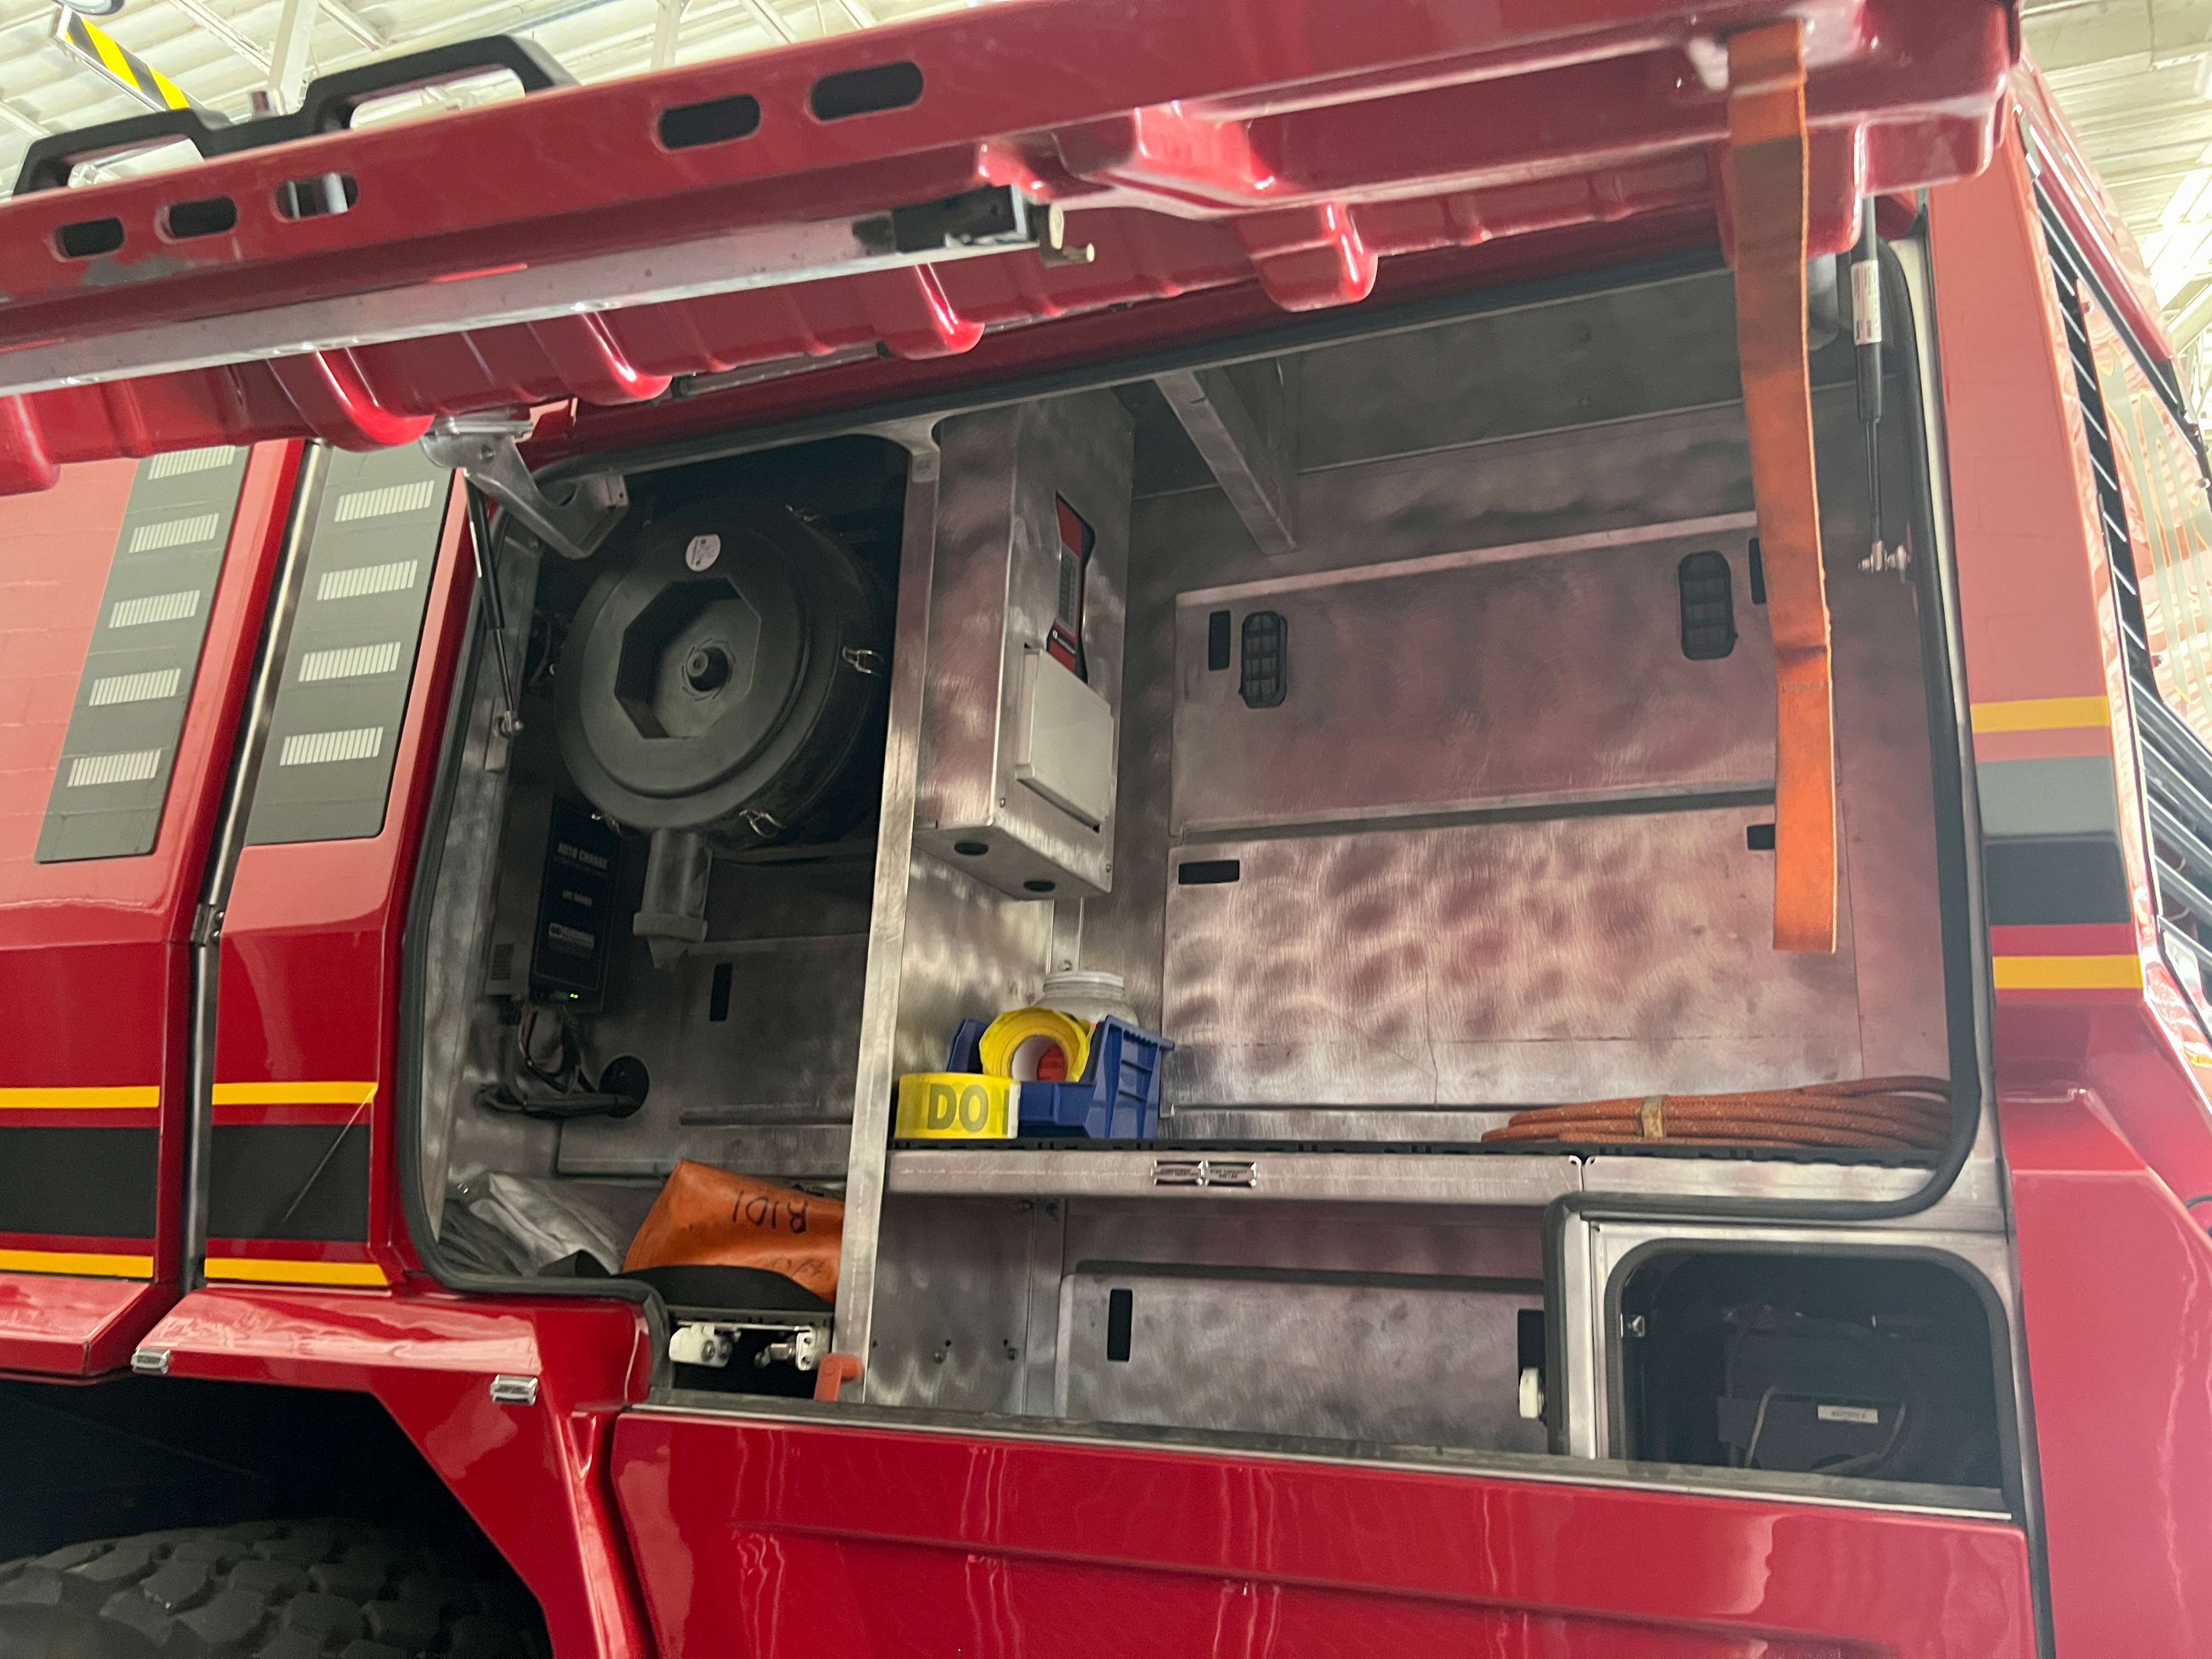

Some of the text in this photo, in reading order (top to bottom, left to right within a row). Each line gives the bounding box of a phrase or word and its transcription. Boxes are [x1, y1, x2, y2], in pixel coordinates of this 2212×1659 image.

[557, 843, 578, 860] AUTO
[579, 850, 607, 870] CHARGE
[927, 1083, 989, 1133] DO
[733, 1190, 808, 1234] R101
